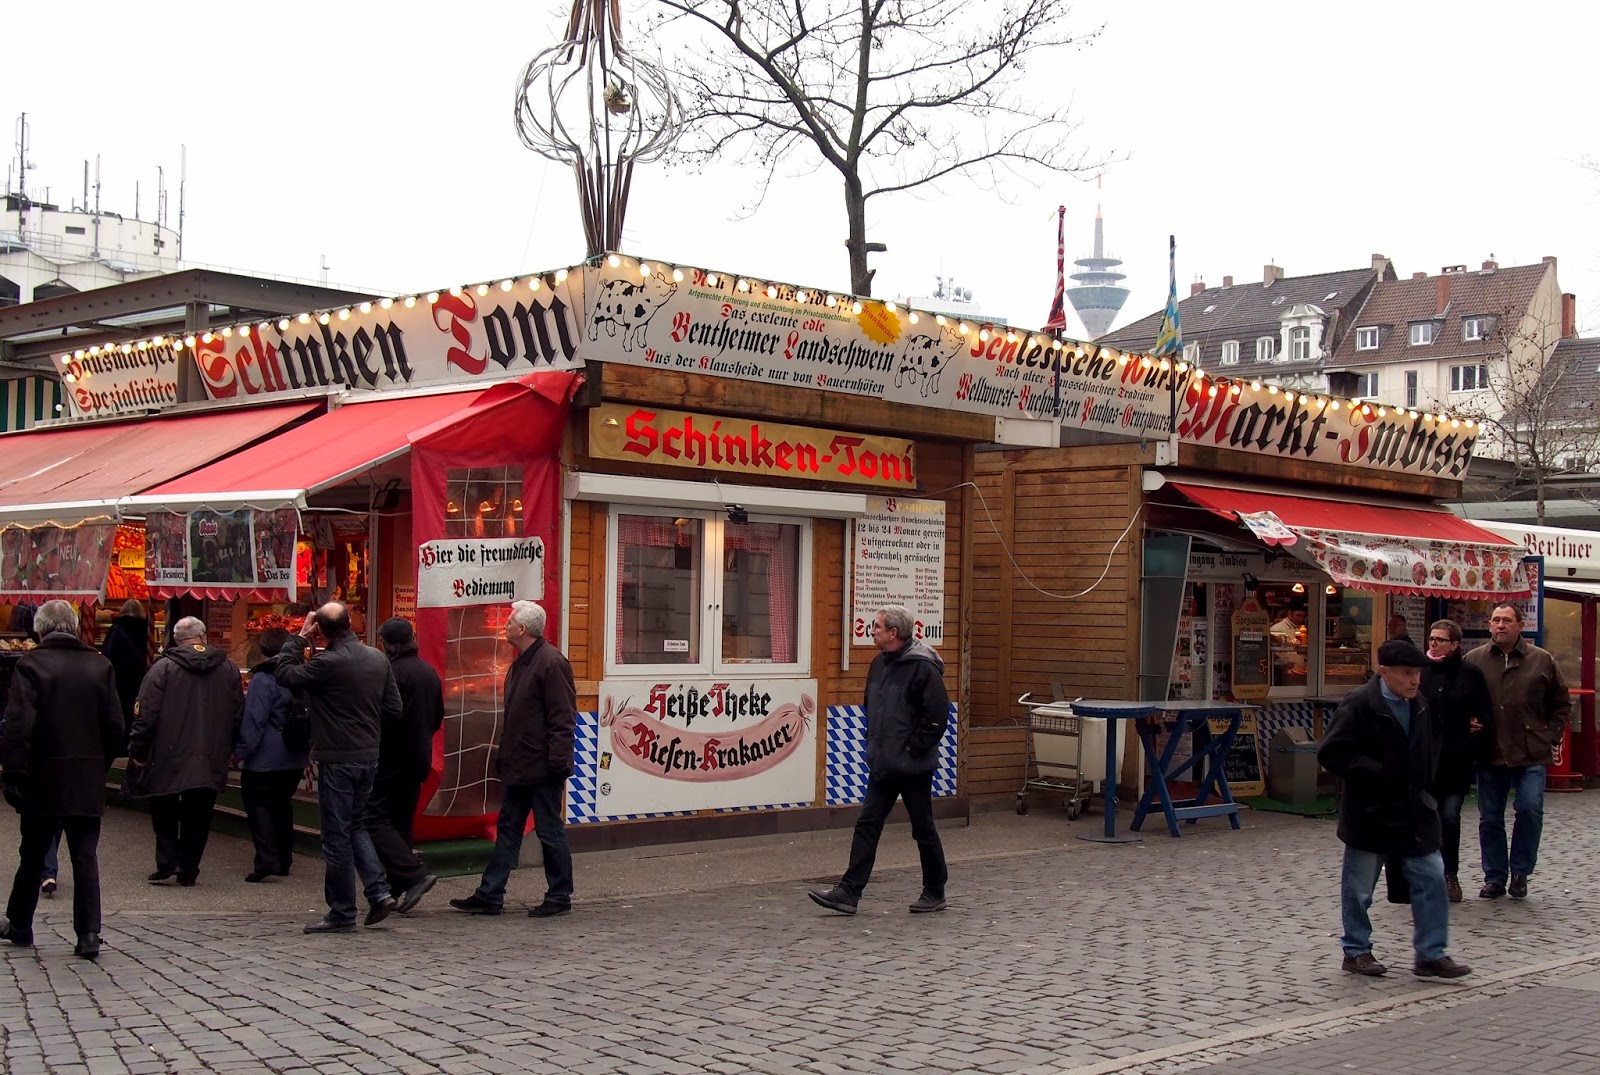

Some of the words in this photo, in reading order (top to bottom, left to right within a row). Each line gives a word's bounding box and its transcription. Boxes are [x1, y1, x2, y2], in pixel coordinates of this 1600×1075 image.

[692, 269, 724, 290] Nu
[688, 288, 721, 302] Artgerechte
[750, 299, 761, 309] und
[762, 301, 795, 315] Schlachtung
[803, 308, 851, 323] Privatschlachthaus
[721, 303, 746, 319] Das
[751, 311, 798, 328] exelente
[803, 319, 825, 332] edle
[195, 316, 415, 399] Schinken
[432, 275, 578, 375] Toni
[670, 311, 780, 357] Bentheimer
[783, 330, 895, 374] Landschwein
[644, 347, 671, 365] Aus
[675, 352, 696, 369] der
[698, 355, 764, 377] Klausheide
[768, 369, 789, 381] nur
[793, 371, 812, 384] von
[817, 373, 885, 396] Bauernhöfen
[995, 365, 1020, 382] Nach
[1022, 370, 1046, 384] alter
[1118, 386, 1155, 402] Tradition
[1178, 374, 1477, 477] Markt-Imbiss
[622, 408, 914, 484] Schinken-Toni
[857, 523, 866, 532] 12
[869, 524, 879, 533] bis
[882, 524, 891, 534] 24
[894, 525, 920, 537] Monate
[923, 529, 944, 540] gereift
[861, 536, 913, 549] Luftgetrocknet
[916, 541, 931, 550] oder
[933, 541, 940, 550] in
[1523, 532, 1592, 560] Berliner
[421, 545, 453, 570] Hier
[457, 544, 476, 563] die
[481, 541, 543, 567] freundliche
[861, 548, 902, 561] Buchenholz
[905, 552, 940, 563] geräuchert
[1189, 554, 1215, 568] ingang
[1219, 554, 1247, 567] Imbiss
[453, 578, 515, 599] Bedienung
[915, 620, 942, 640] Toni
[708, 683, 772, 722] Theke
